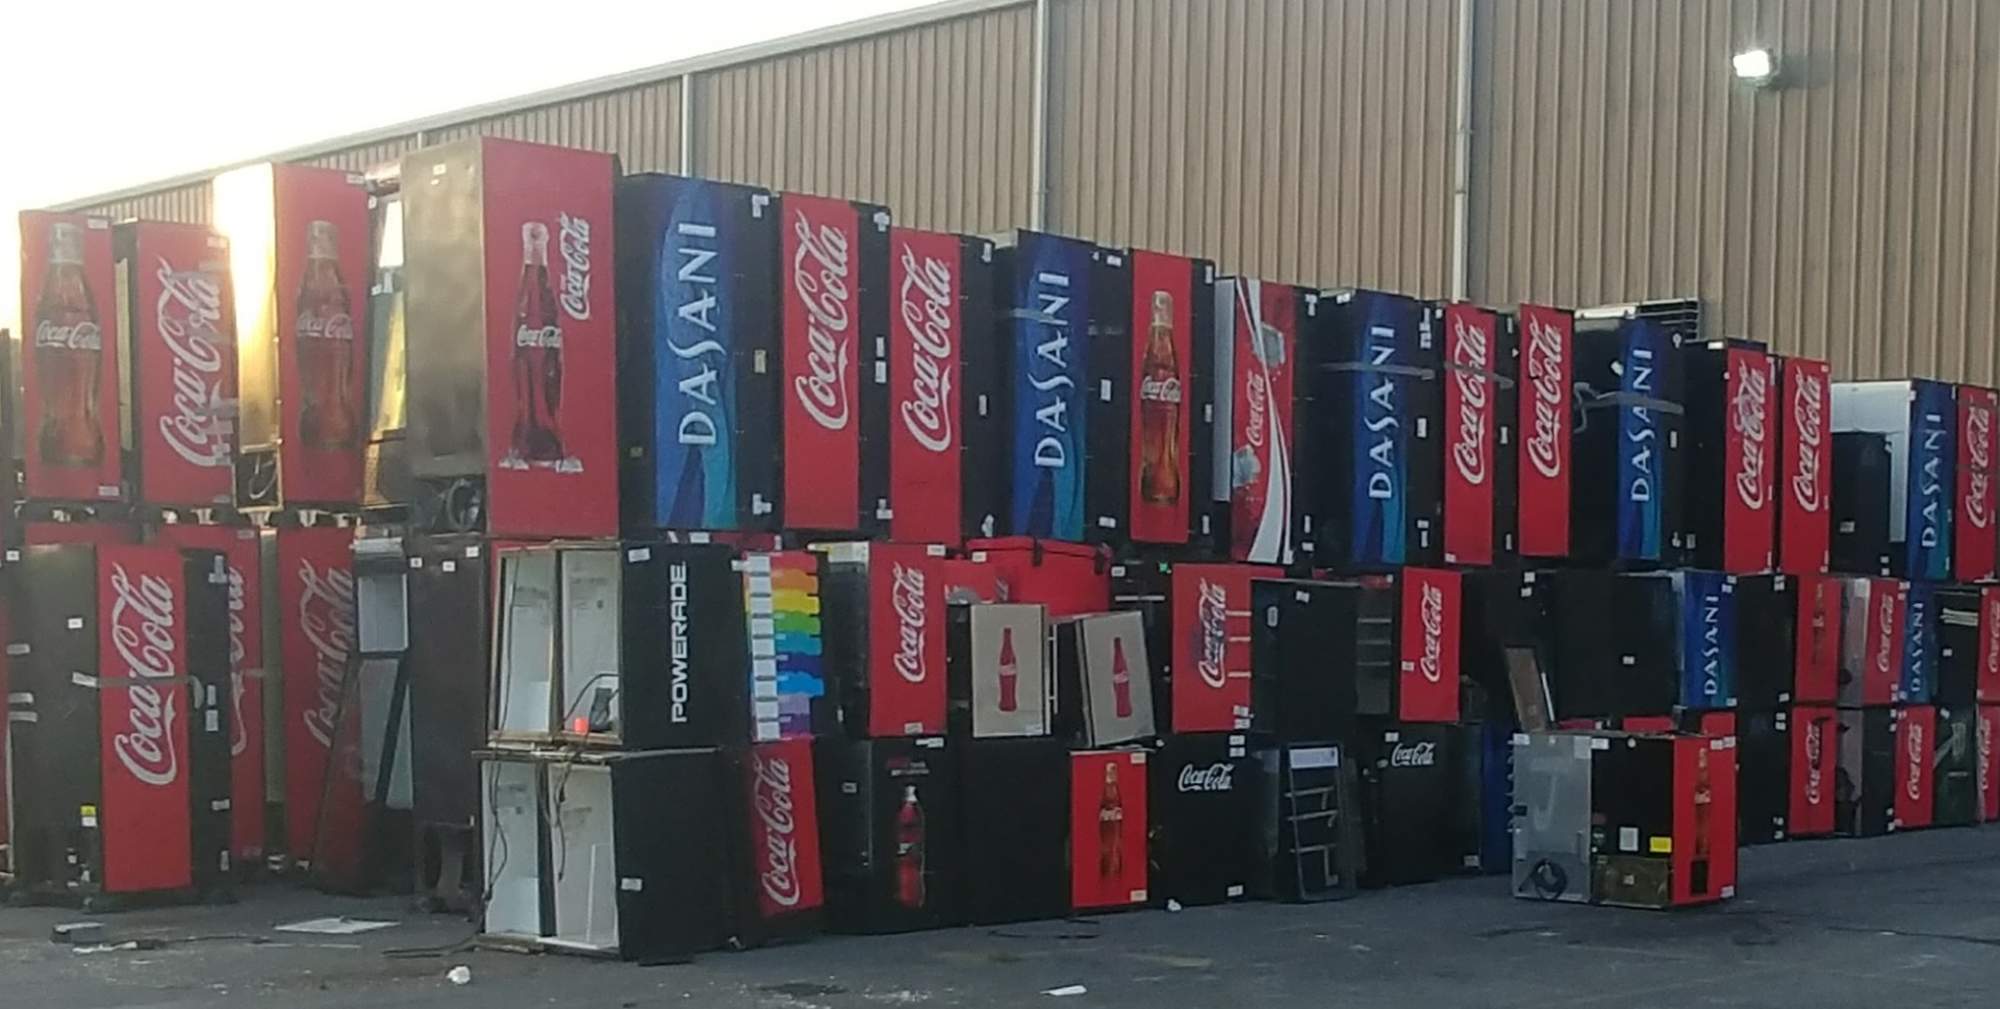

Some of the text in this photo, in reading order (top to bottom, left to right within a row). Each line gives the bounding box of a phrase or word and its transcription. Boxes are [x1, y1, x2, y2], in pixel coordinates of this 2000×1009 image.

[560, 212, 590, 320] Coca-Cola
[668, 223, 727, 446] DASANI
[795, 209, 848, 430] Coca-Cola
[156, 254, 222, 467] Coca-Cola
[901, 243, 951, 451] Coca-Cola
[1028, 272, 1074, 468] DASANI
[1246, 370, 1265, 447] Coca-Cola
[1364, 326, 1399, 499] DASANI
[1454, 313, 1487, 485] Coca-Cola
[1528, 313, 1563, 478] Coca-Cola
[1628, 349, 1655, 501] DASANI
[1734, 358, 1765, 511] Coca-Cola
[1792, 362, 1822, 513] Coca-Cola
[1921, 414, 1946, 548] DASANI
[1965, 394, 1990, 529] Coca-Cola
[111, 561, 177, 786] Coca-Cola
[670, 561, 688, 723] POWERADE
[893, 561, 926, 683] Coca-Cola
[1420, 581, 1443, 682] Coca-Cola
[1704, 595, 1720, 696] DASANI
[1911, 602, 1924, 692] DASANI
[752, 752, 800, 906] Coca-Cola
[1178, 763, 1234, 792] Coca-Cola
[1391, 742, 1436, 767] Coca-Cola
